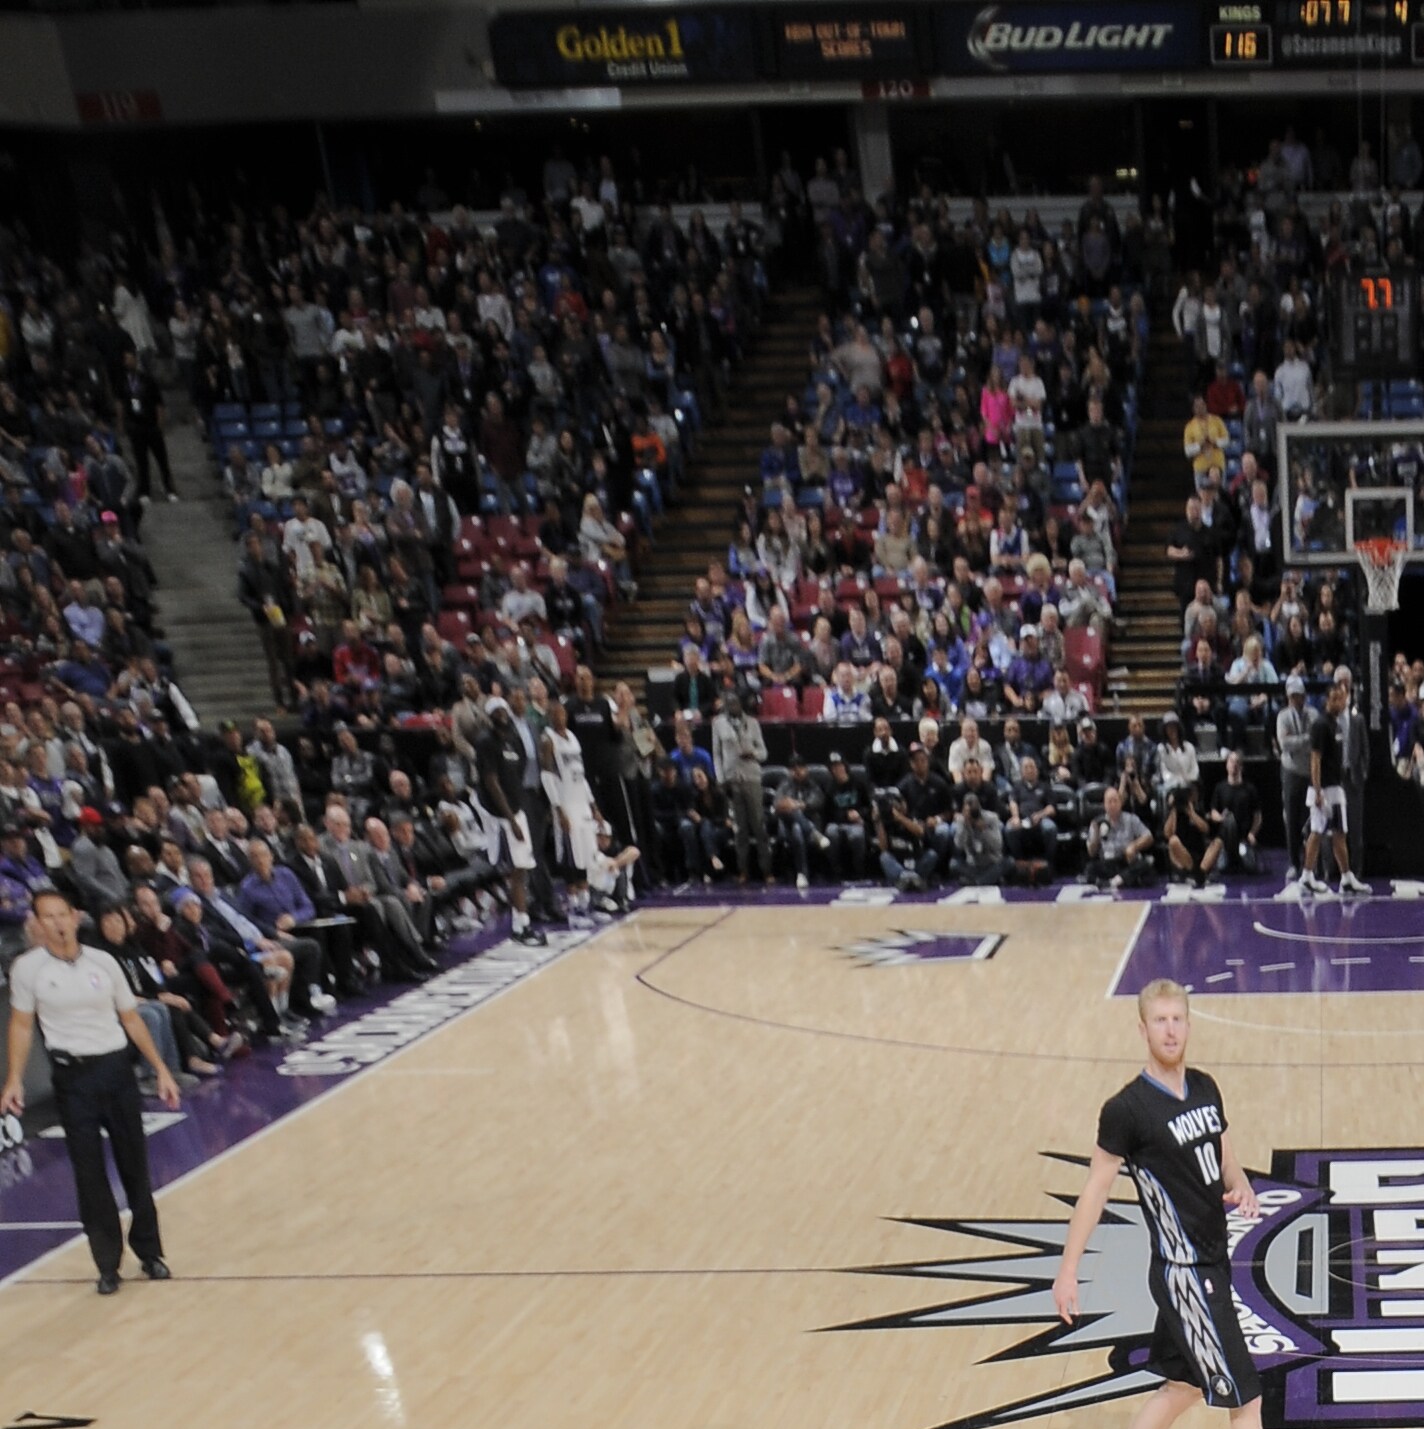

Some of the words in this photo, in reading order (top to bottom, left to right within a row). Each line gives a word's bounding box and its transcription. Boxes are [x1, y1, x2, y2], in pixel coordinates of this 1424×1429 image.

[1218, 5, 1262, 22] KINGS
[556, 23, 666, 62] Golden
[983, 22, 1063, 50] BUD
[1064, 20, 1173, 49] LIGHT
[1225, 32, 1257, 59] 116
[877, 80, 915, 98] 120
[1167, 1104, 1222, 1147] WOLVES
[1193, 1141, 1221, 1186] 10
